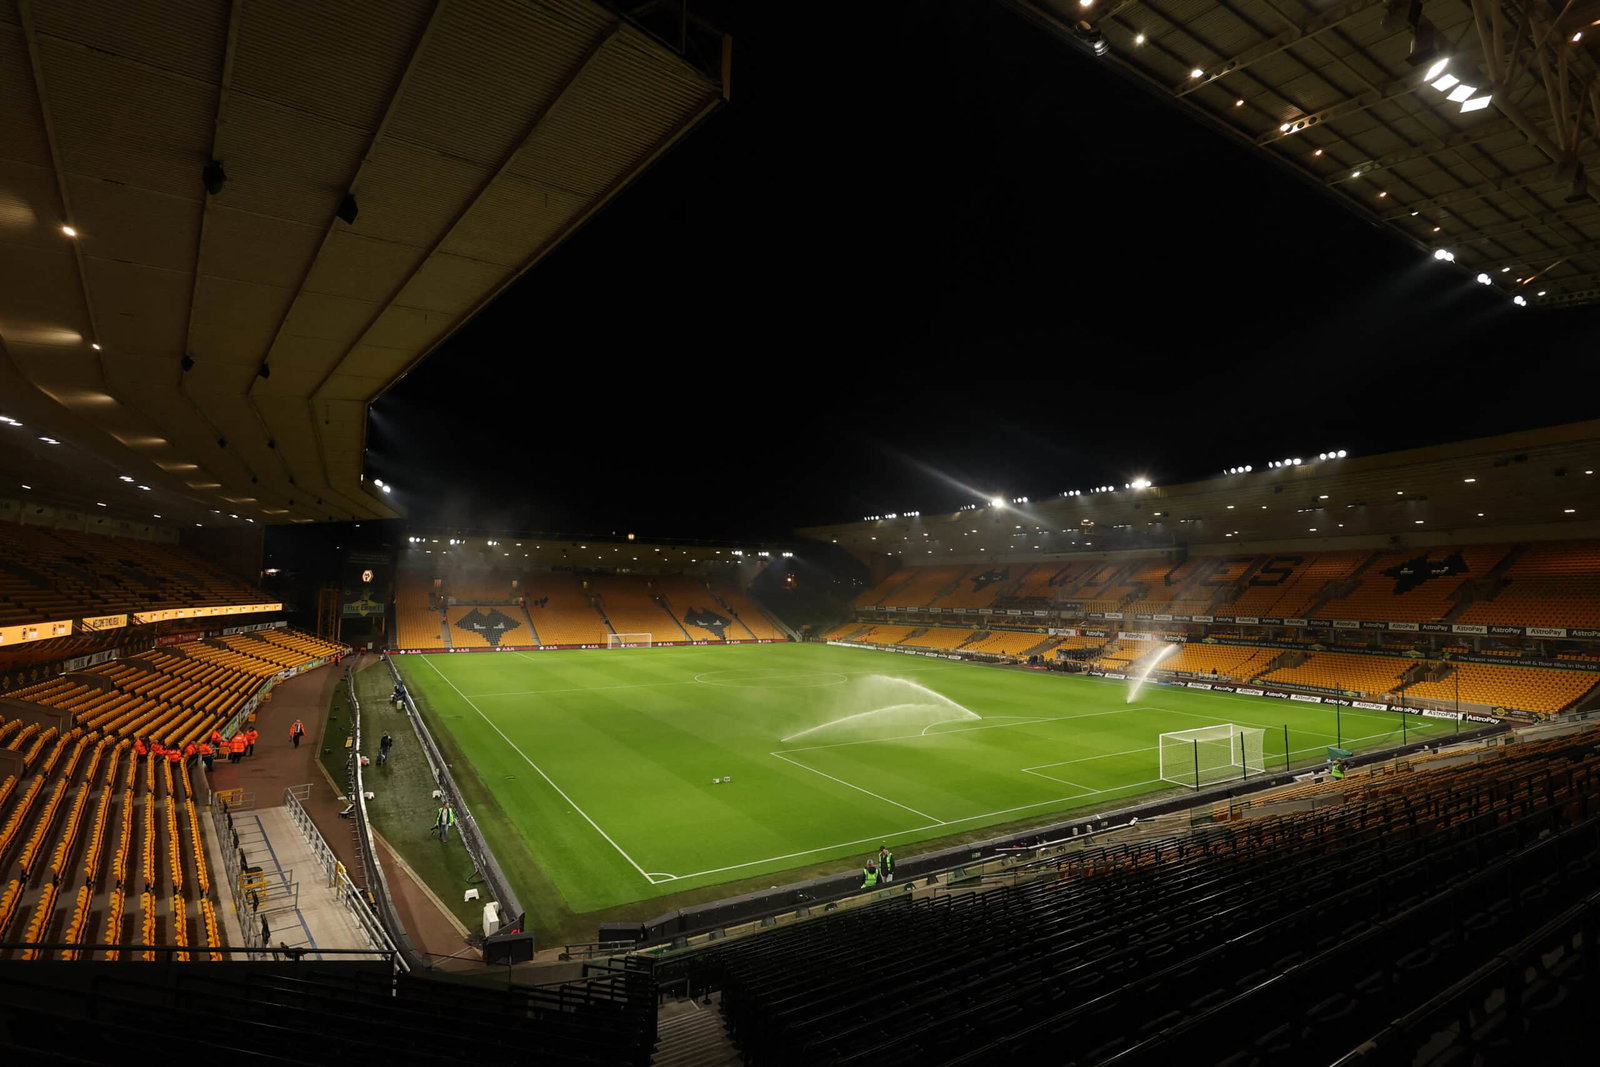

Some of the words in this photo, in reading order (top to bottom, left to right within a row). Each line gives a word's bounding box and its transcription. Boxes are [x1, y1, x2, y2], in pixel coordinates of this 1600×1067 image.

[1357, 701, 1383, 710] AstroPay
[1427, 710, 1458, 719] AstroPay
[1468, 714, 1500, 724] AstroPay
